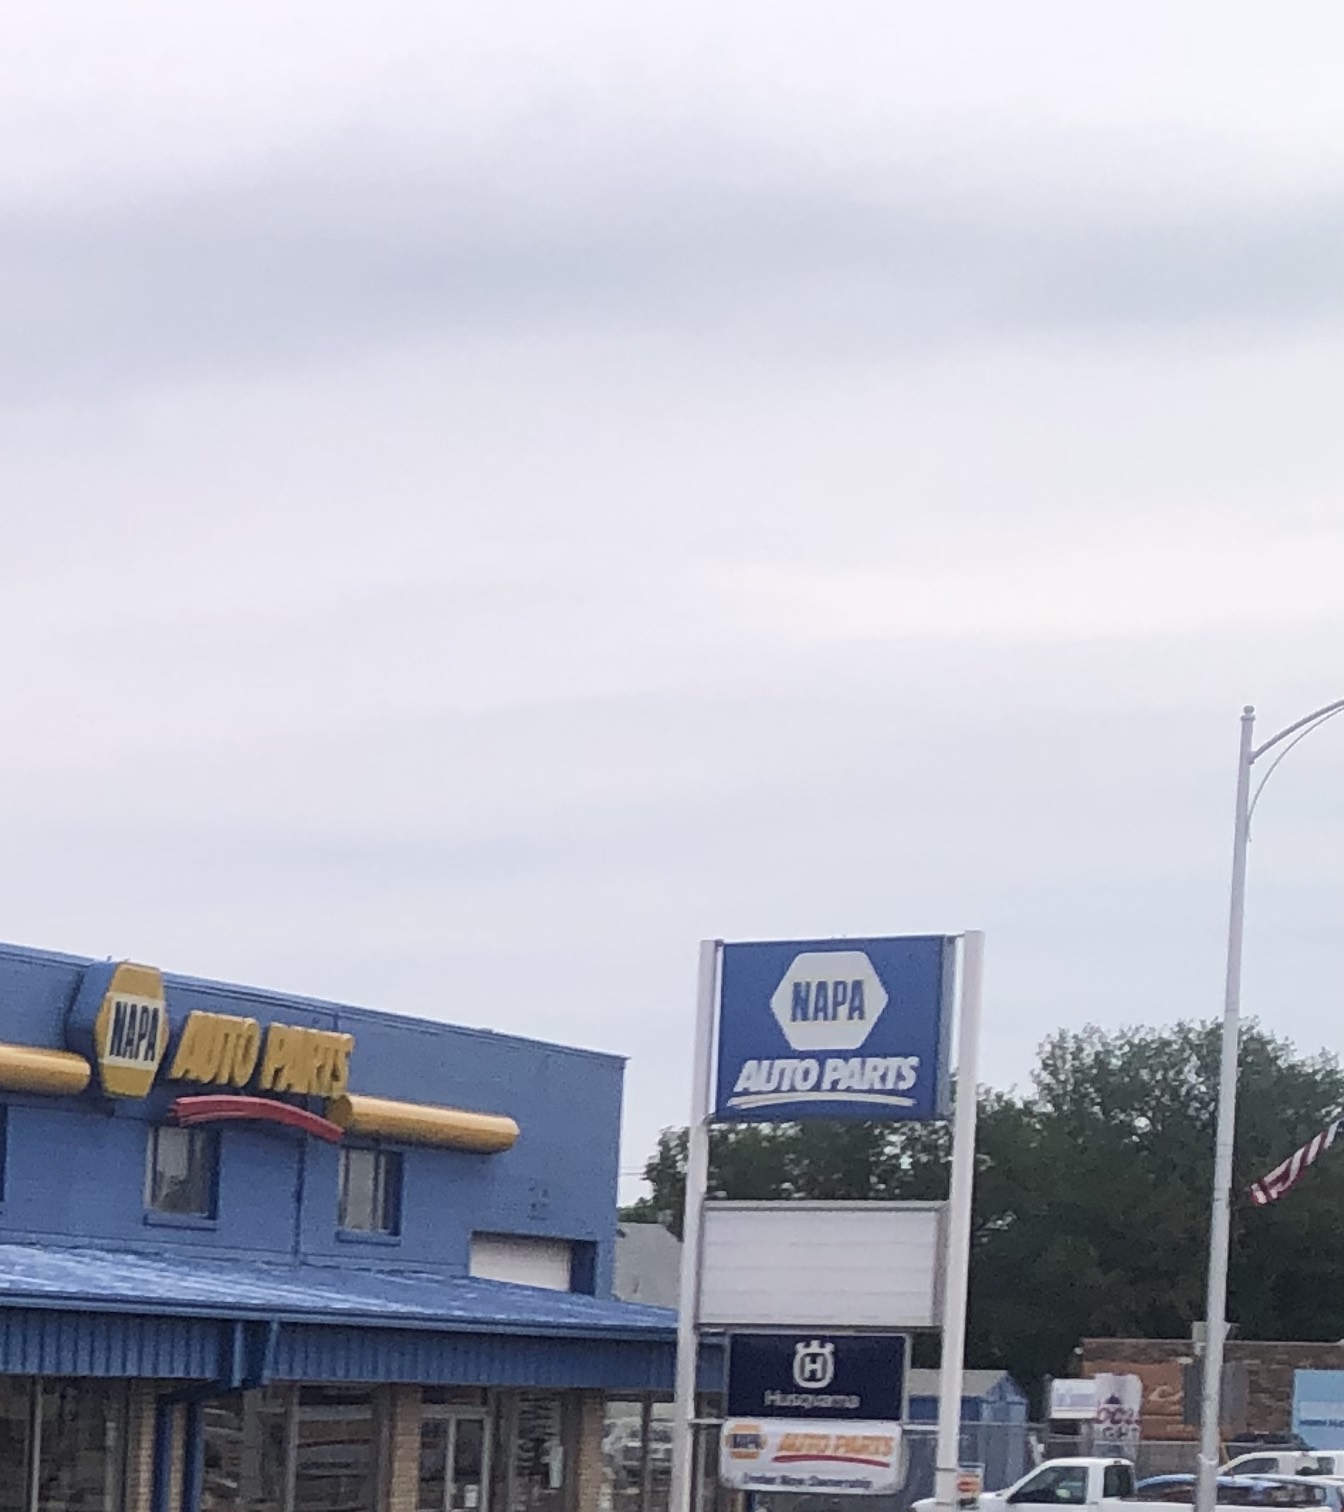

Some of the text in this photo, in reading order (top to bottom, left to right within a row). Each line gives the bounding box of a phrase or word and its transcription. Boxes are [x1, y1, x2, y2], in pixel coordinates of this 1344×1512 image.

[790, 979, 866, 1022] NAPA
[109, 1001, 160, 1061] NAPA
[170, 1009, 355, 1097] AUTO PARTS
[733, 1055, 920, 1092] AUTO PARTS
[764, 1389, 861, 1409] Husqvarna
[778, 1432, 894, 1456] AUTO PARTS
